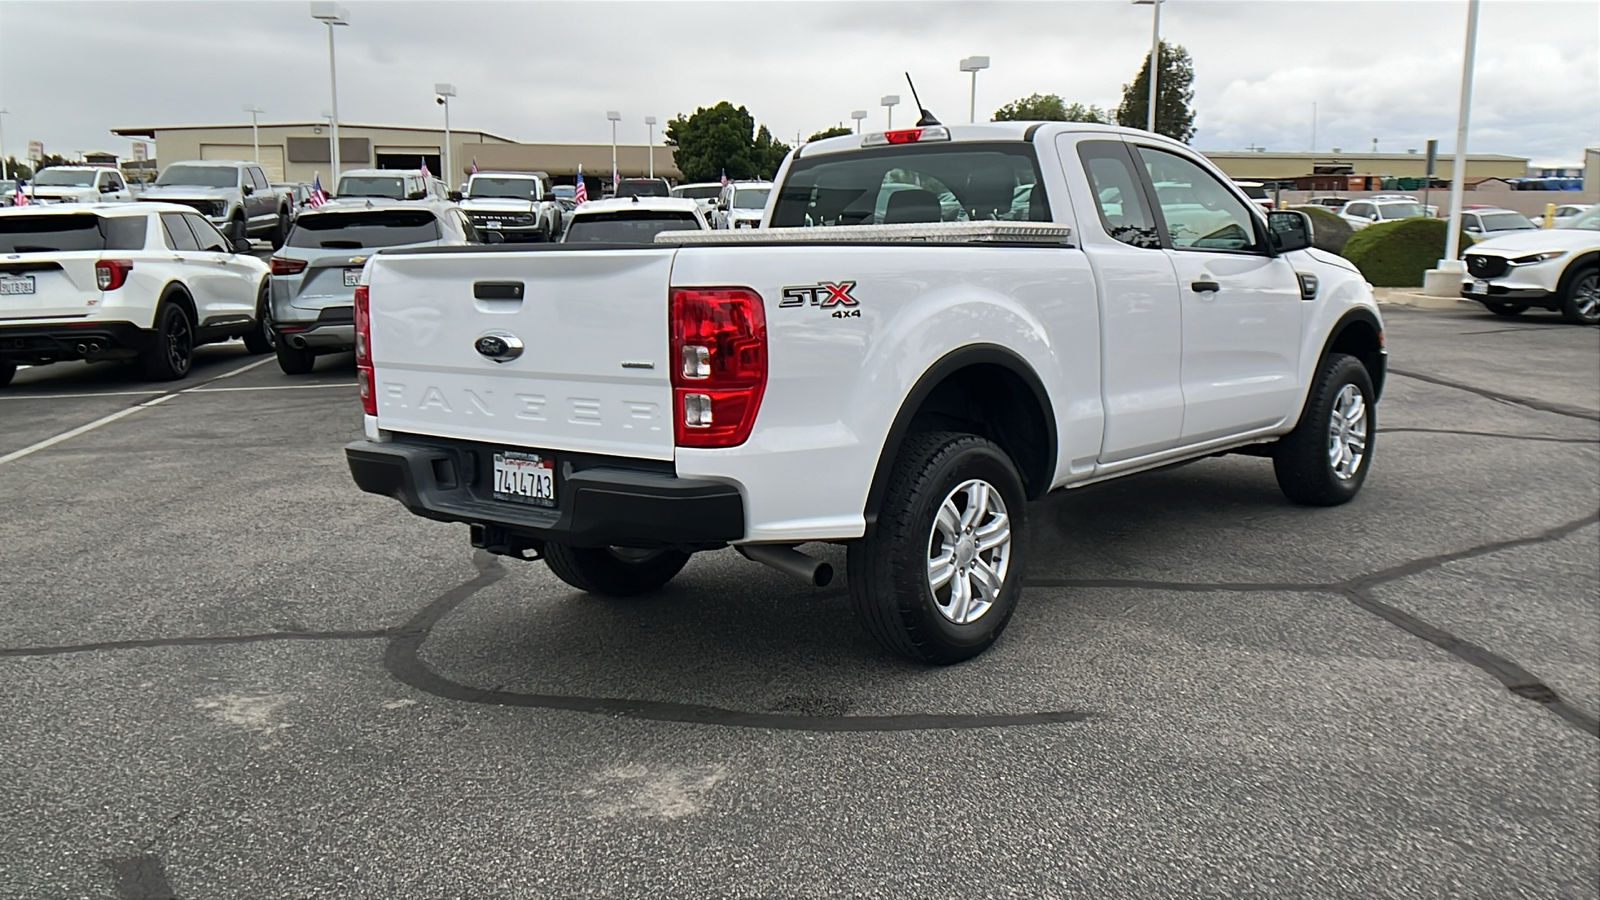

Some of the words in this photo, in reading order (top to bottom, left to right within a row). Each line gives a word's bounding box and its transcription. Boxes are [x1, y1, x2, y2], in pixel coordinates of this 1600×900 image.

[779, 281, 860, 309] STX
[480, 338, 502, 353] Ford
[382, 381, 662, 431] RANGER
[496, 469, 551, 498] 74147A3
